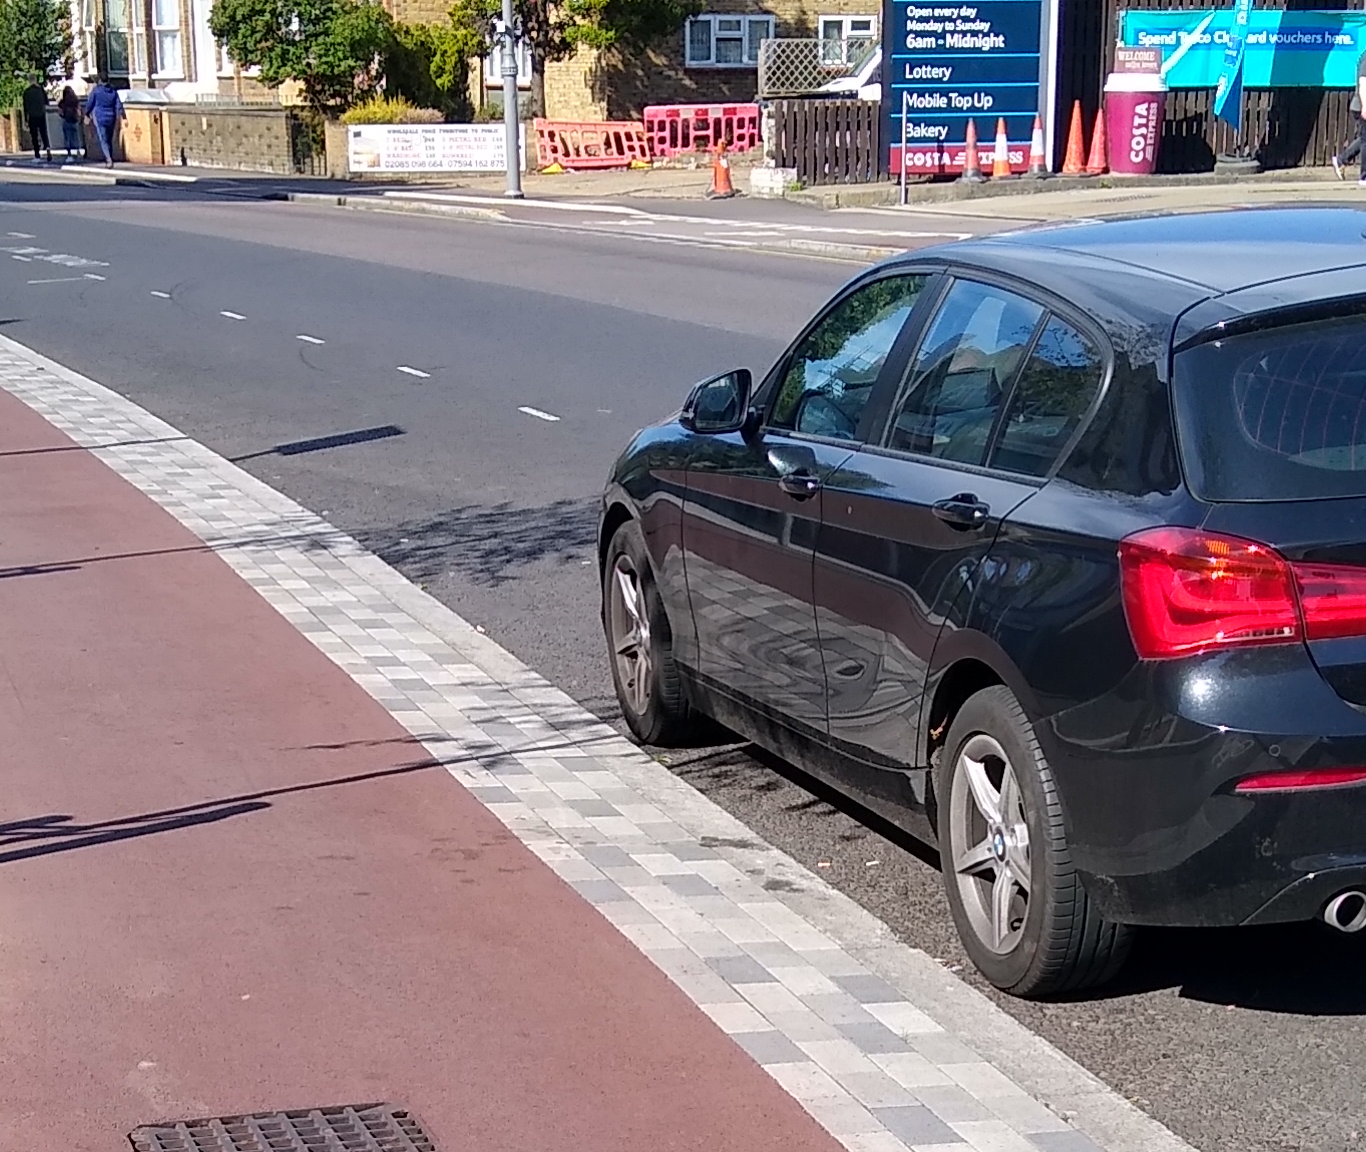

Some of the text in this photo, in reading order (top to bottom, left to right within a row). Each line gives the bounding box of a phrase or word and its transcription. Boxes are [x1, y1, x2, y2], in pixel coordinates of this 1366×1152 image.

[906, 5, 977, 18] Open every day
[906, 19, 991, 33] Monday to Sunday
[906, 34, 936, 48] 6am
[945, 33, 1005, 51] Midnight
[1138, 31, 1176, 47] Spend
[1178, 31, 1212, 46] Tco
[1269, 30, 1322, 44] vouchers
[1117, 50, 1156, 61] WELCOME
[905, 63, 952, 81] Lottery
[905, 92, 993, 110] Mobile Top Up
[906, 122, 949, 140] Bakery
[1129, 102, 1149, 163] COSTA
[905, 151, 952, 167] COSTA
